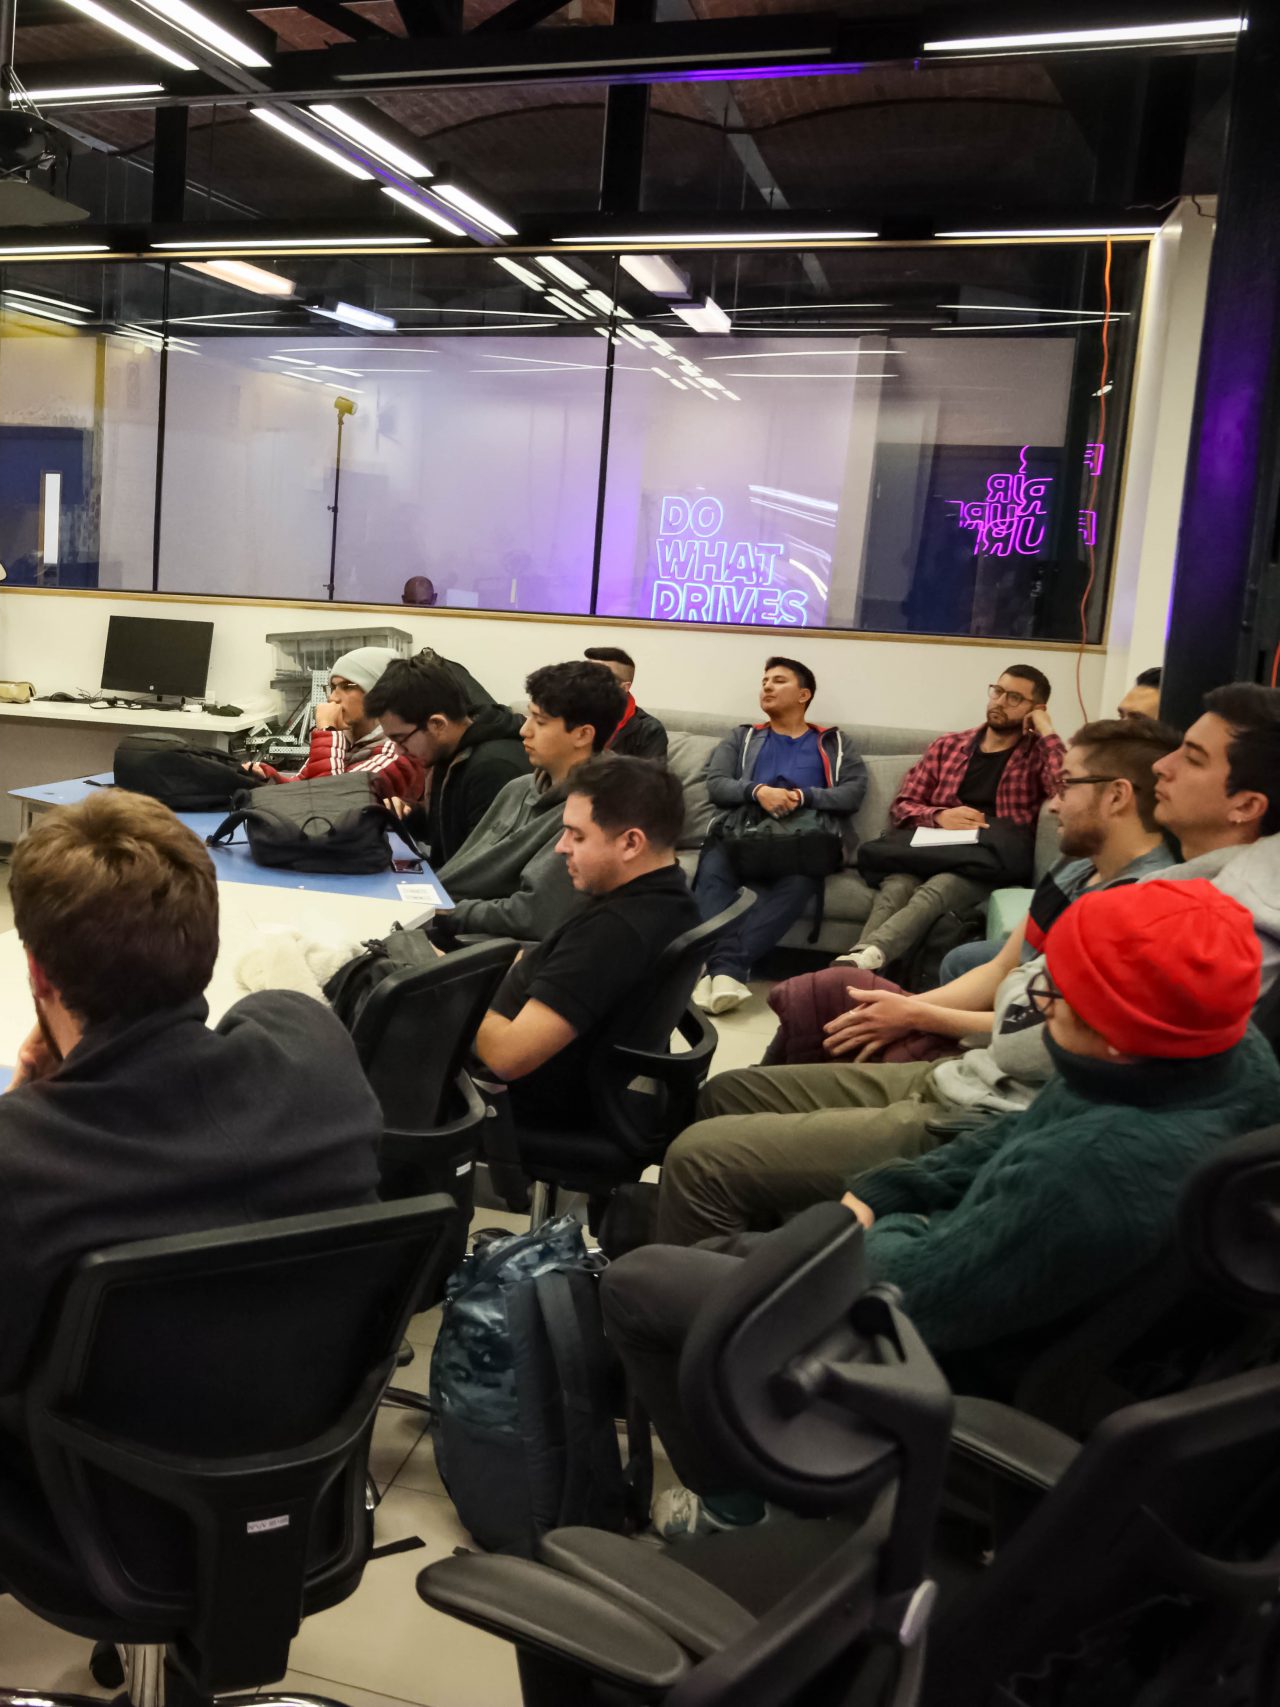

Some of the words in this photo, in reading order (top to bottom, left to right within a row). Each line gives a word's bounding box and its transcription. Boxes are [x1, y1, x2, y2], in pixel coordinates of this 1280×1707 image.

[659, 495, 725, 539] DO
[655, 538, 785, 587] WHAT
[650, 581, 809, 628] DRIVES
